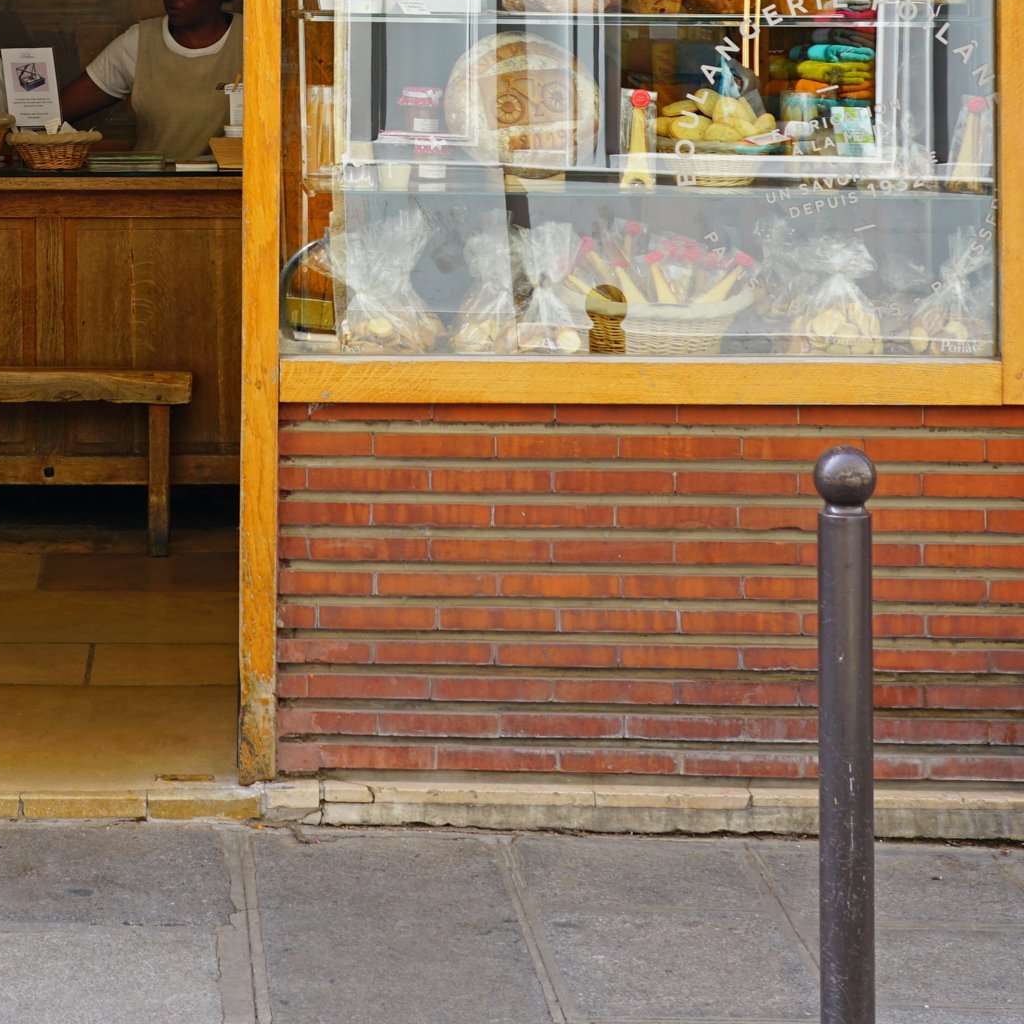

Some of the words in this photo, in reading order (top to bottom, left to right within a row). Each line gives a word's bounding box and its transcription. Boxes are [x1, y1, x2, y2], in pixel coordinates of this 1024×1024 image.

[811, 136, 835, 152] LA
[765, 187, 791, 205] UN
[789, 191, 858, 219] DEPUIS
